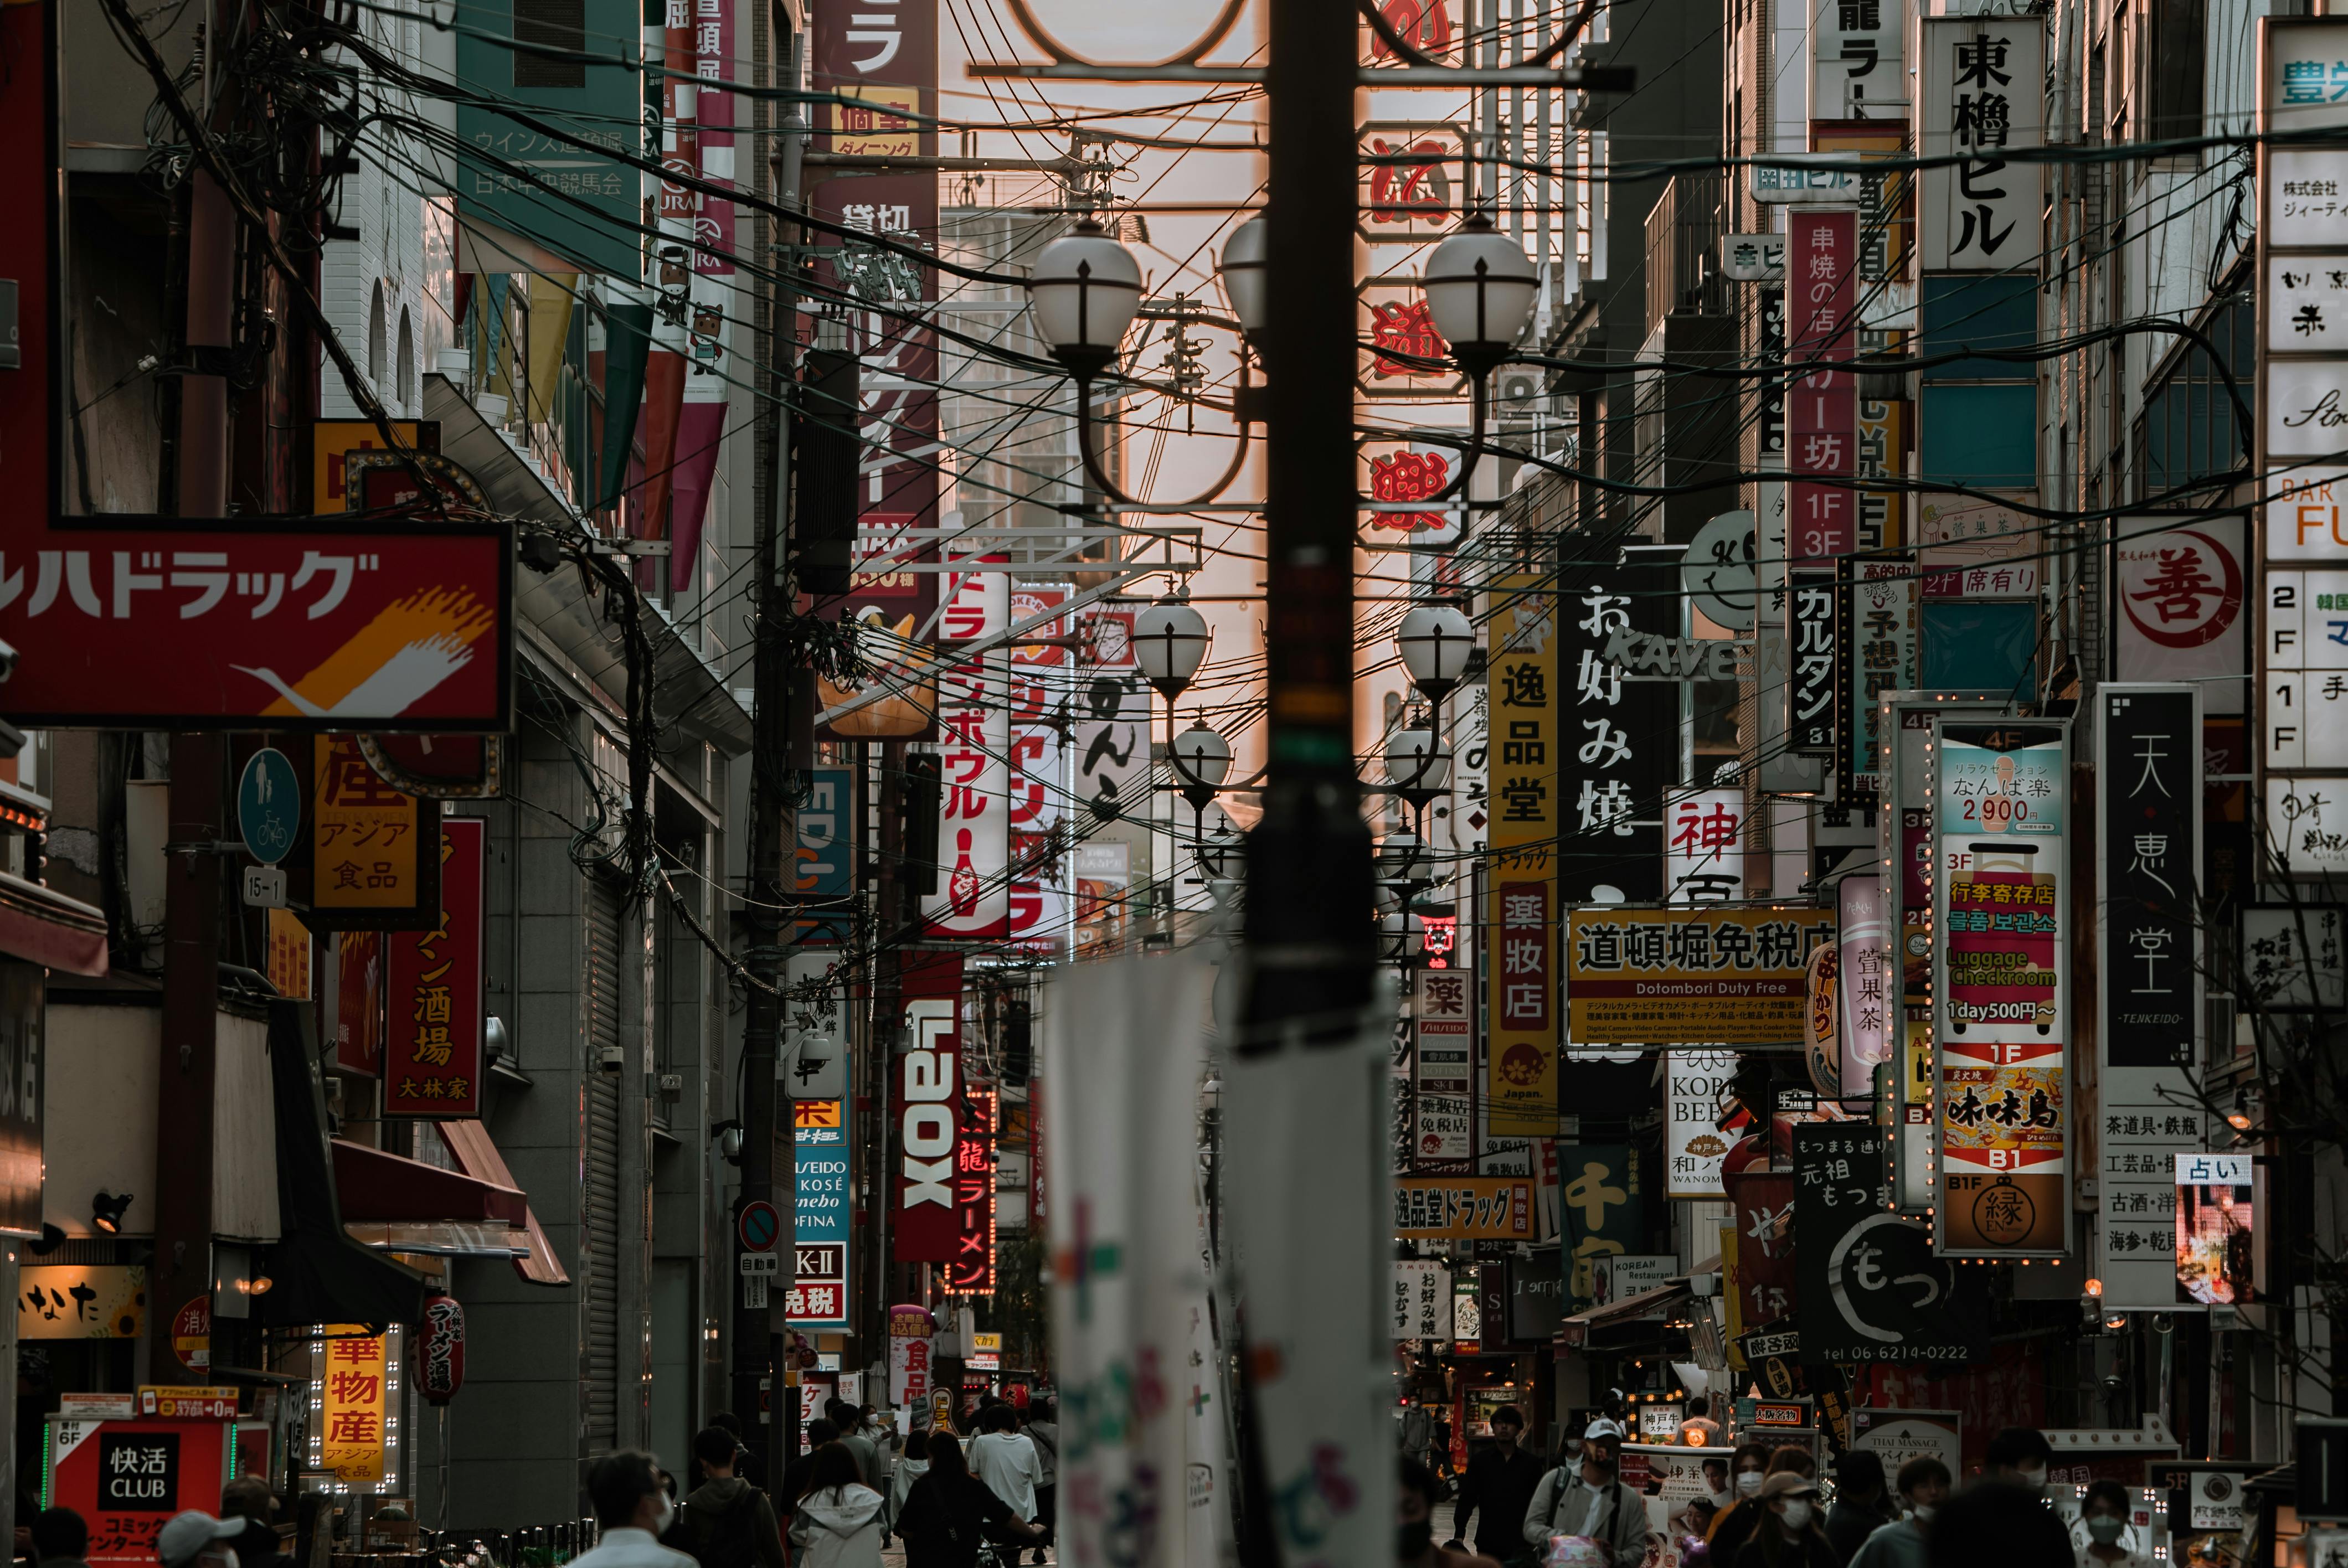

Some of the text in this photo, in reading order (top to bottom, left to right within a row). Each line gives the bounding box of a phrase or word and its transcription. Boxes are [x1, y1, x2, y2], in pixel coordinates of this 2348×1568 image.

[839, 101, 911, 135] 個室
[838, 142, 913, 156] ダイニング
[476, 172, 624, 196] 日本中央競馬会
[2283, 180, 2338, 197] 株式会社
[1809, 226, 1837, 333] 串焼の店
[1808, 493, 1842, 519] 1F
[1804, 530, 1842, 556] 3F
[1966, 568, 2035, 592] 席有り
[2130, 547, 2225, 624] 善
[2197, 595, 2242, 644] ZEN
[1604, 624, 1738, 682] KAVE
[1796, 586, 1835, 720] カルダン
[1577, 585, 1635, 837] お好み焼
[1501, 662, 1548, 822] 逸品堂
[1984, 731, 2022, 748] 4F
[1955, 763, 2047, 776] リラクゼーション
[1953, 777, 2052, 798] なんば楽
[1963, 800, 2028, 822] 2,900
[320, 821, 410, 848] アジア
[1497, 849, 1549, 872] ドラッグ
[1947, 854, 1973, 870] 3F
[332, 860, 398, 890] 食品
[249, 878, 280, 901] 15-1
[1950, 882, 2056, 905] 行李寄存店
[1846, 900, 1873, 914] PEACH
[1947, 911, 2057, 933] 물품 보관소
[1947, 947, 2028, 970] Luggage
[1951, 968, 2057, 987] Checkroom
[1426, 976, 1463, 1014] 薬
[1636, 982, 1787, 996] Dotombori Duty Free
[1423, 1024, 1468, 1033] SHISEIDO
[1990, 1044, 2022, 1063] 1F
[1423, 1067, 1465, 1075] SOFINA
[398, 1077, 468, 1100] 大林家
[1503, 1089, 1543, 1099] Japan.
[1420, 1117, 1468, 1133] 免税店
[1692, 1142, 1722, 1153] 神戸牛
[1799, 1140, 1854, 1154] もつまる
[1988, 1149, 2021, 1168] B1
[2190, 1158, 2238, 1181] 占い
[801, 1177, 843, 1190] KOSÉ
[1801, 1159, 1851, 1187] 元祖
[1948, 1176, 1982, 1190] B1F
[1393, 1187, 1511, 1230] 逸品堂ドラッグ
[1986, 1220, 2005, 1232] EN
[742, 1258, 776, 1271] 自動車
[1615, 1261, 1656, 1271] KOREAN
[1852, 1241, 1939, 1309] もつ
[1629, 1272, 1674, 1280] Restaurant
[18, 1281, 98, 1323] なた
[785, 1287, 835, 1315] 免税
[1420, 1273, 1435, 1335] お好み焼
[450, 1302, 464, 1342] 大林家
[894, 1313, 925, 1324] 全商品
[425, 1303, 453, 1392] ラーメン酒場
[1823, 1345, 1968, 1360] tel 06-6214-0222
[904, 1339, 929, 1406] 食品
[1644, 1412, 1680, 1425] 神戸牛
[59, 1432, 80, 1445] 6F
[1899, 1438, 1940, 1448] MASSAGE
[110, 1447, 168, 1474] 快活
[326, 1448, 379, 1461] アジア
[335, 1464, 371, 1478] 食品
[110, 1478, 166, 1498] CLUB
